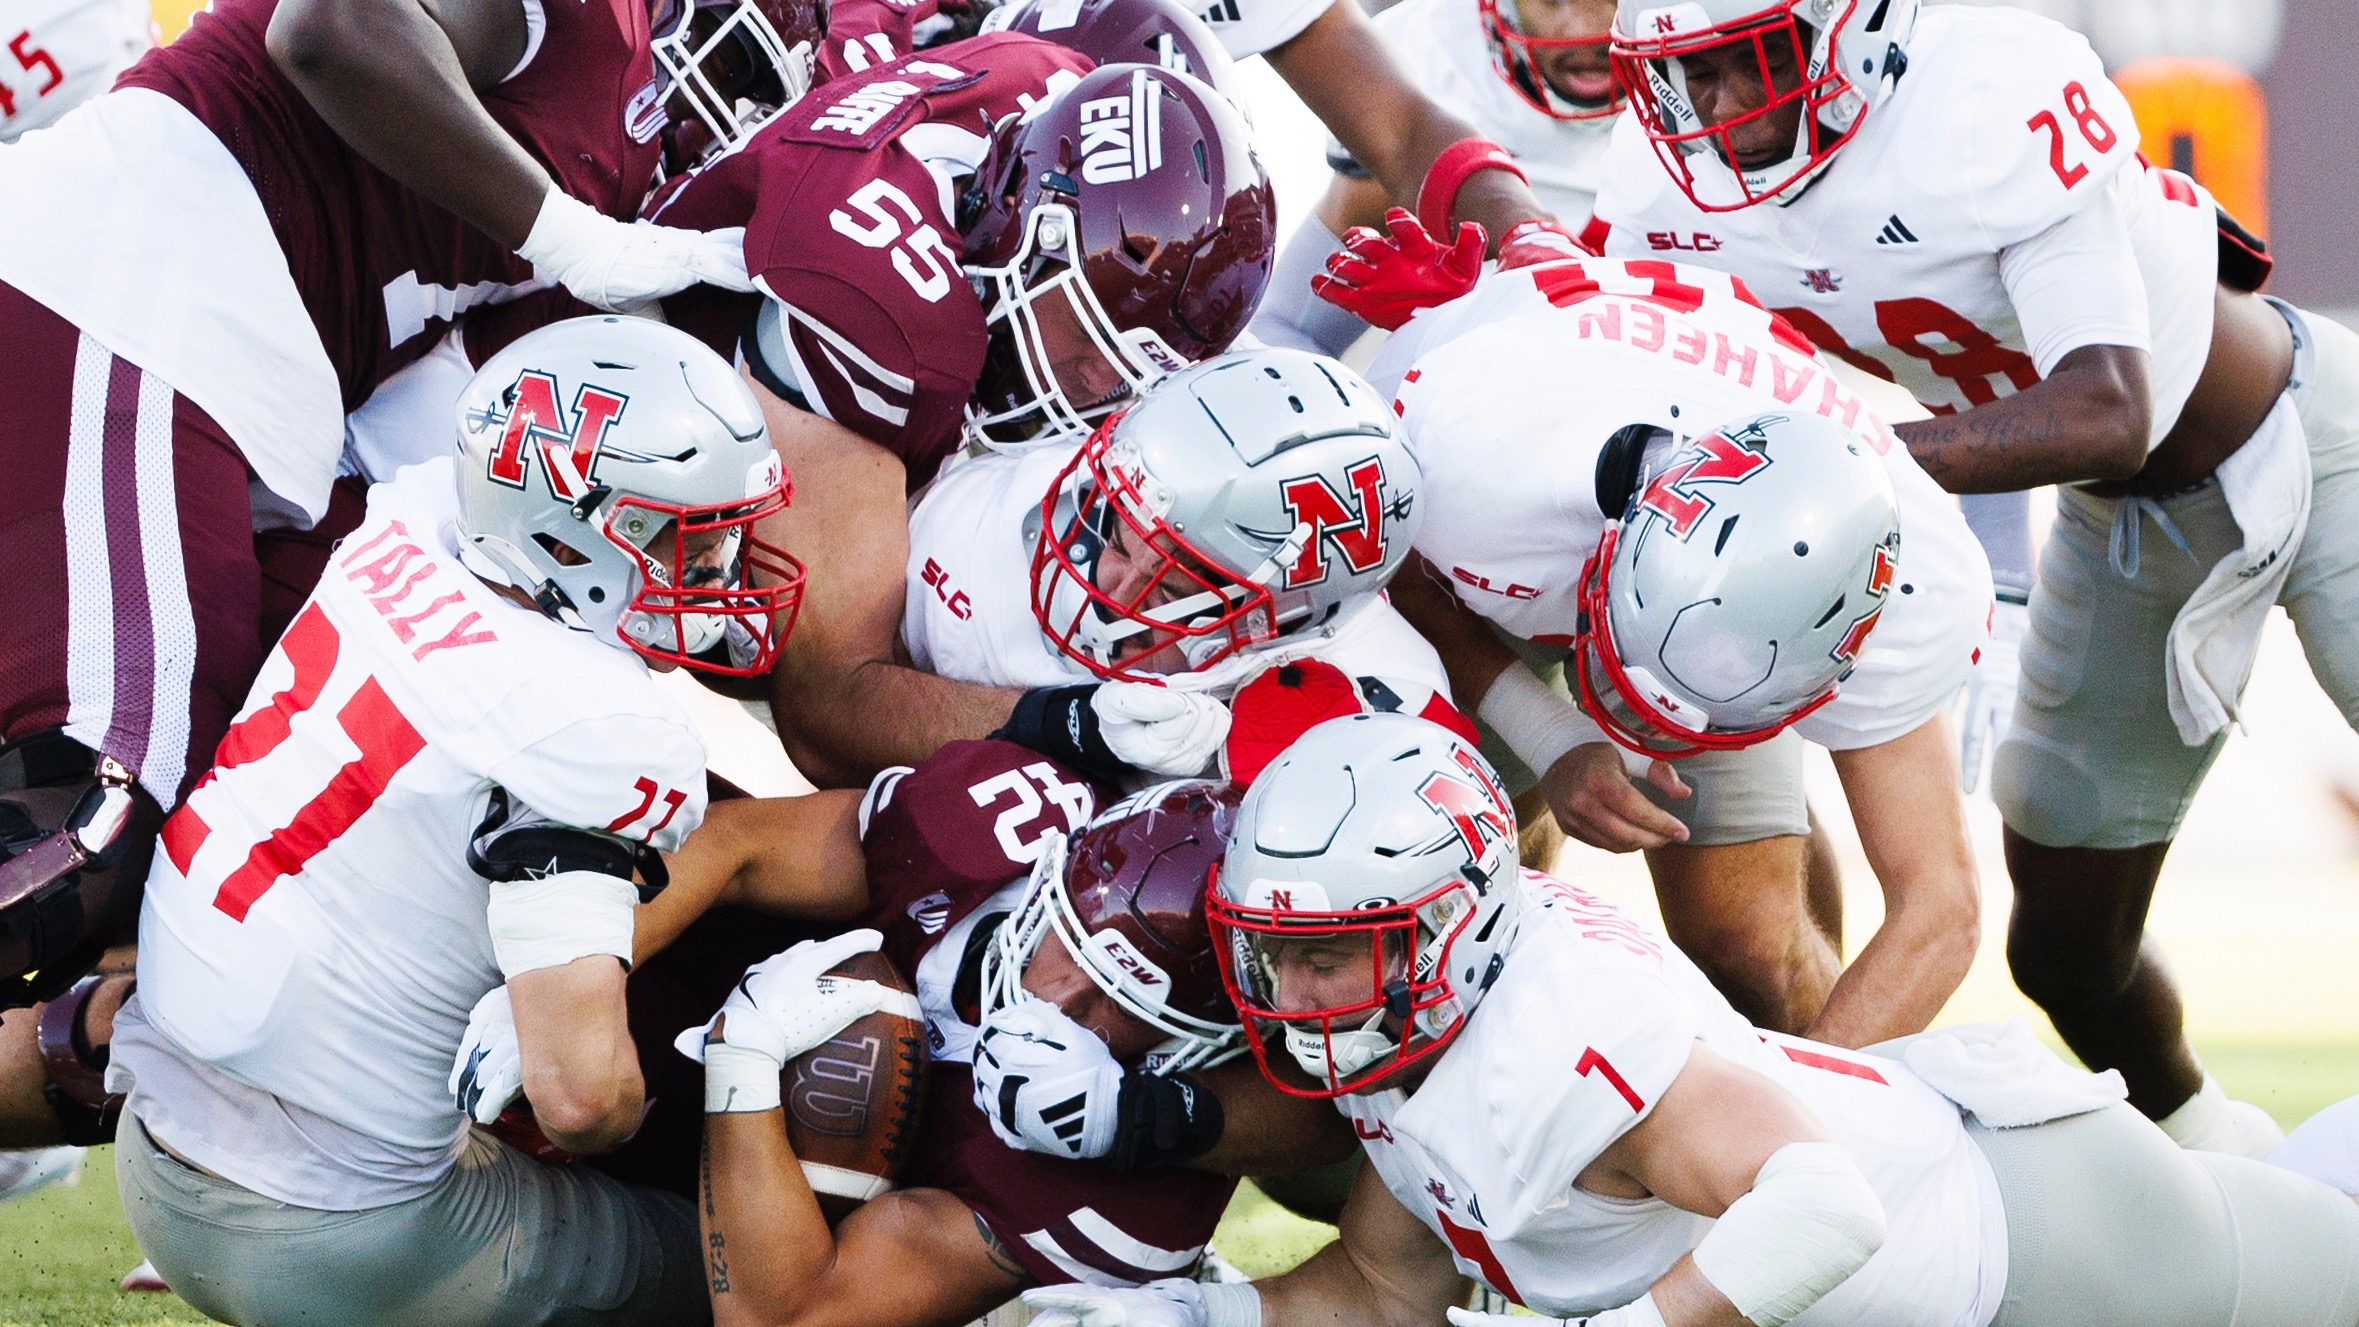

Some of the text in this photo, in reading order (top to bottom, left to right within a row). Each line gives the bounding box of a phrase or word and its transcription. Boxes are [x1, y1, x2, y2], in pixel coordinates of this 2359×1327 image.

[1080, 95, 1133, 185] EKU
[1649, 74, 1694, 122] Riddell
[2026, 80, 2117, 191] 28
[828, 177, 965, 303] 55
[1646, 231, 1718, 252] SLC
[1138, 340, 1183, 372] E2W
[1578, 303, 1893, 457] SHAHEEN
[487, 367, 630, 505] N
[1635, 425, 1775, 545] N
[1279, 454, 1389, 592] N
[340, 519, 499, 663] TALLY
[920, 556, 972, 621] SLC
[1104, 942, 1163, 986] E2W
